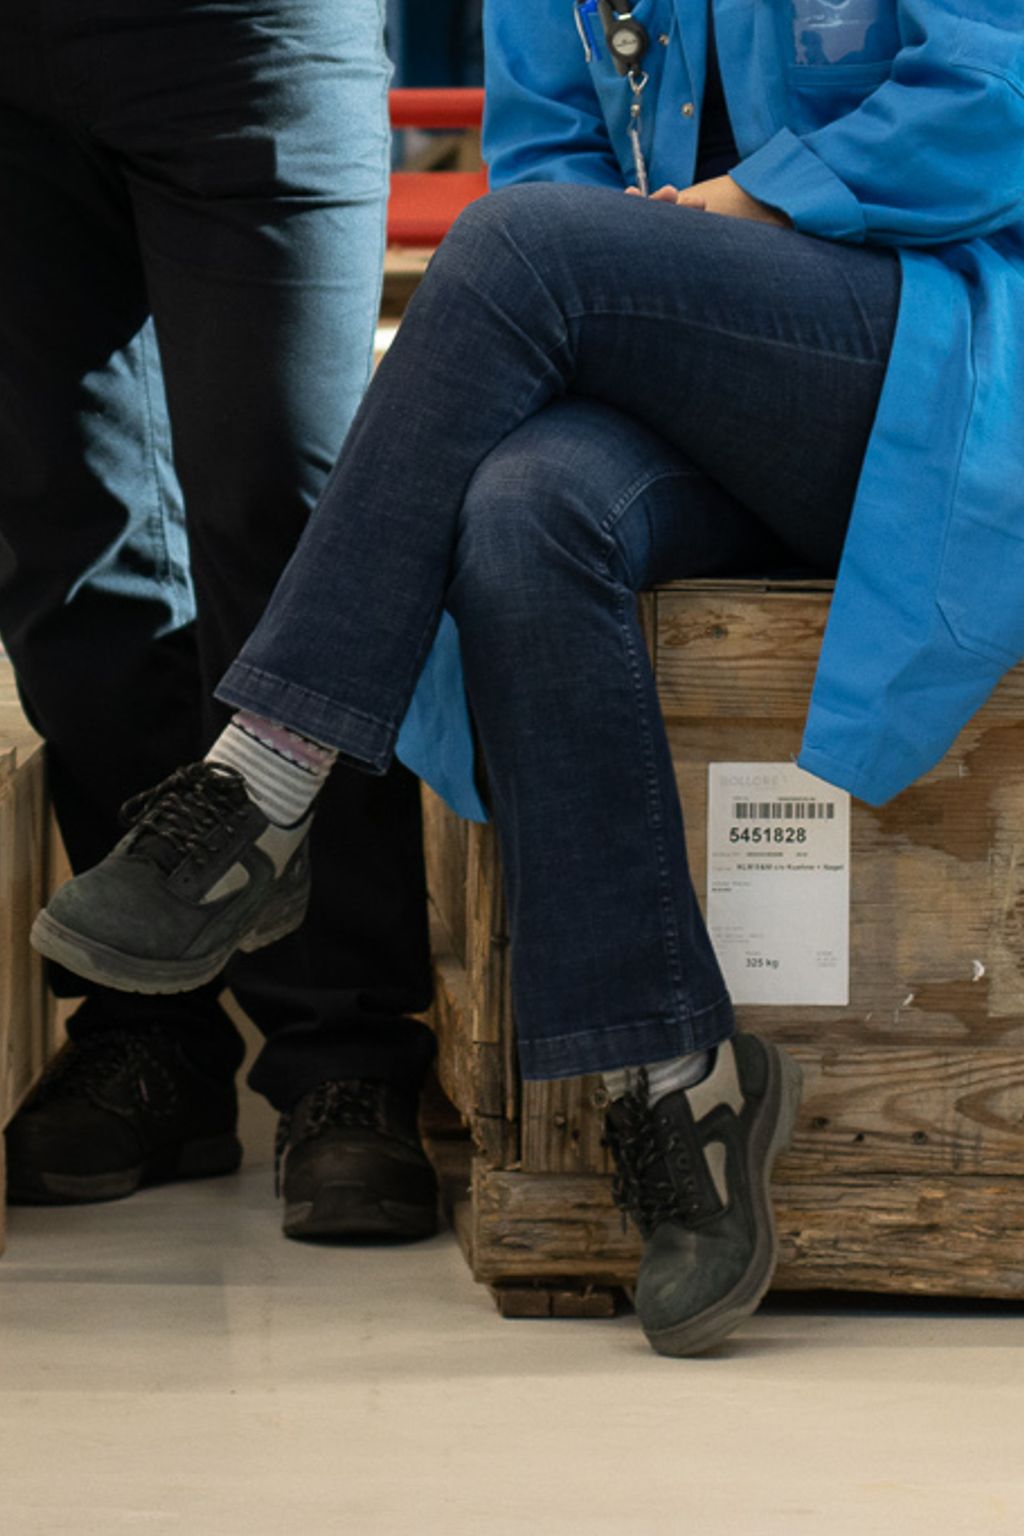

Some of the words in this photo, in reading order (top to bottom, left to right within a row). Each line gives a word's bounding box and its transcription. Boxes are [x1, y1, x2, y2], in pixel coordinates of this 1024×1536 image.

[729, 827, 807, 843] 5451828
[745, 957, 764, 967] 325
[765, 957, 780, 969] kg
